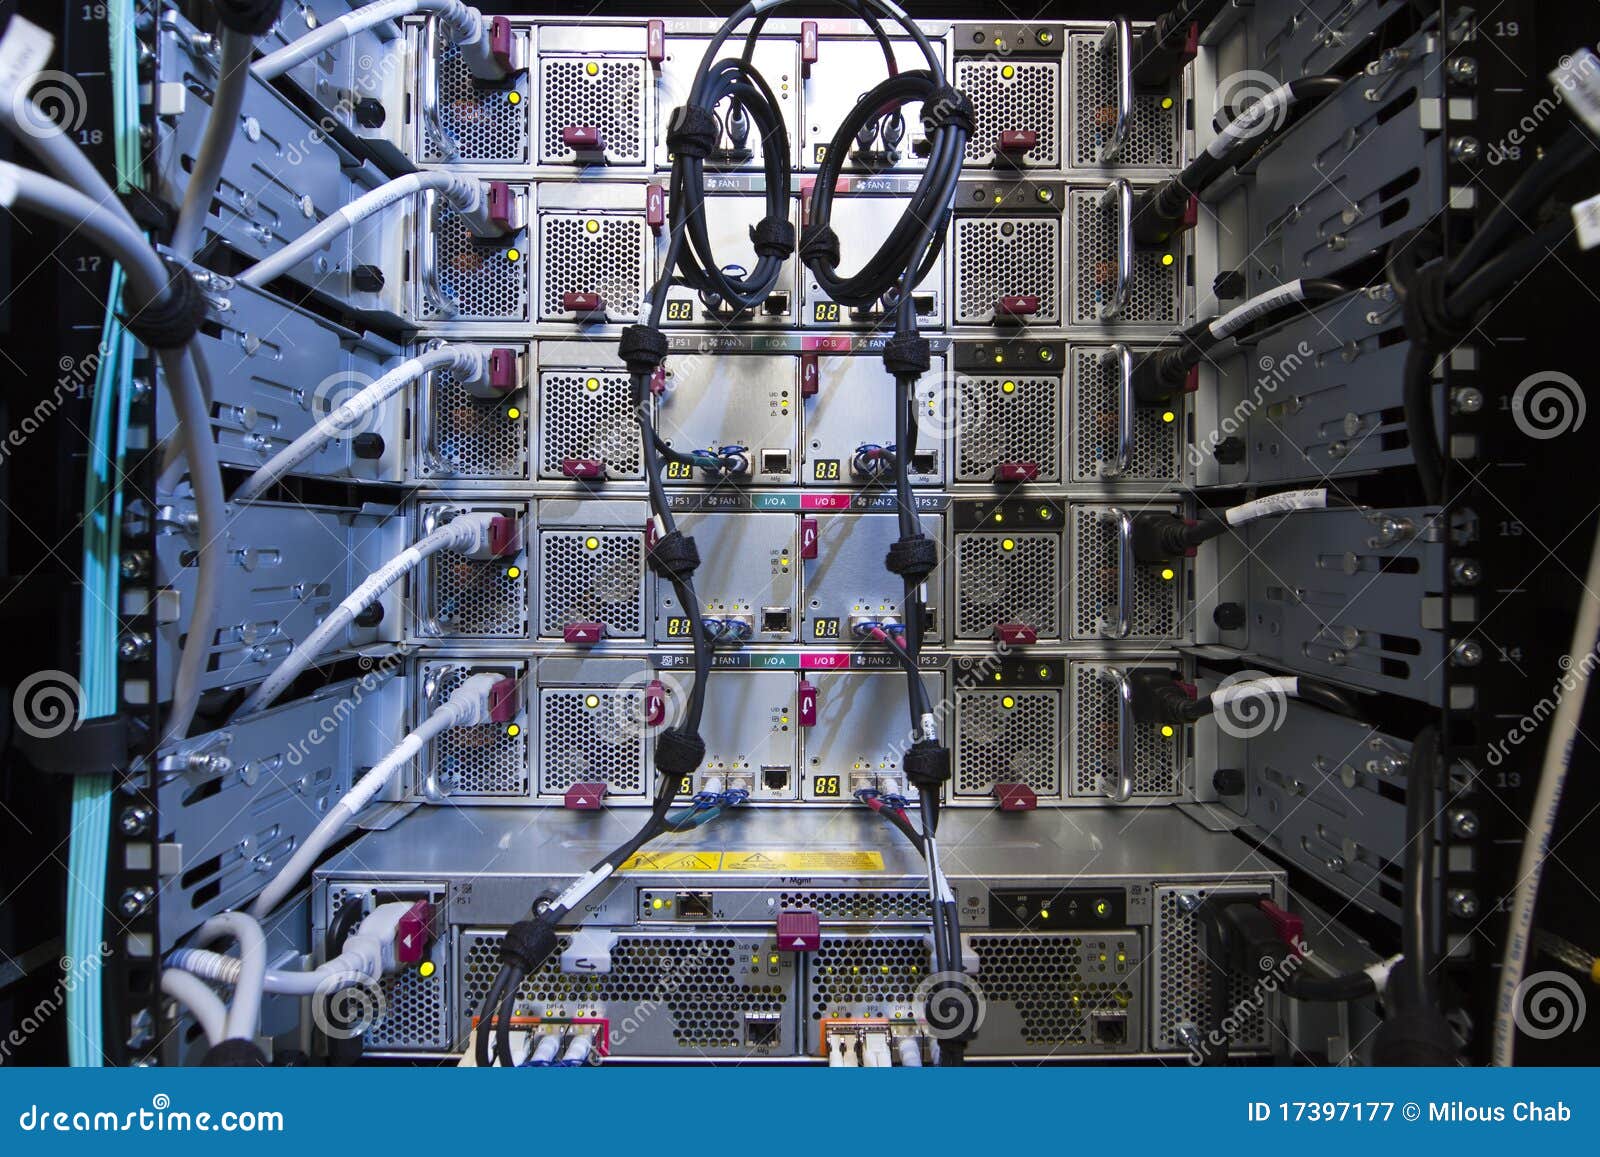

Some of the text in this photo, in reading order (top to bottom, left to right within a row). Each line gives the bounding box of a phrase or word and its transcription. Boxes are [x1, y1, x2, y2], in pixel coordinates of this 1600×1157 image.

[82, 4, 106, 20] 19
[1495, 22, 1519, 37] 19
[79, 129, 103, 145] 18
[718, 179, 735, 188] FAN
[867, 181, 891, 190] FAN 2
[77, 256, 101, 272] 17
[675, 497, 686, 505] PS
[719, 497, 736, 505] FAN
[764, 497, 787, 506] I/O A
[815, 498, 836, 506] I/O B
[886, 498, 892, 506] 2
[921, 498, 938, 506] PS 2
[674, 656, 685, 664] PS
[719, 656, 736, 664] FAN
[764, 656, 786, 665] I/O A
[814, 656, 835, 665] I/O B
[868, 656, 892, 664] FAN 2
[921, 656, 938, 664] PS 2
[789, 876, 812, 885] Mgmt
